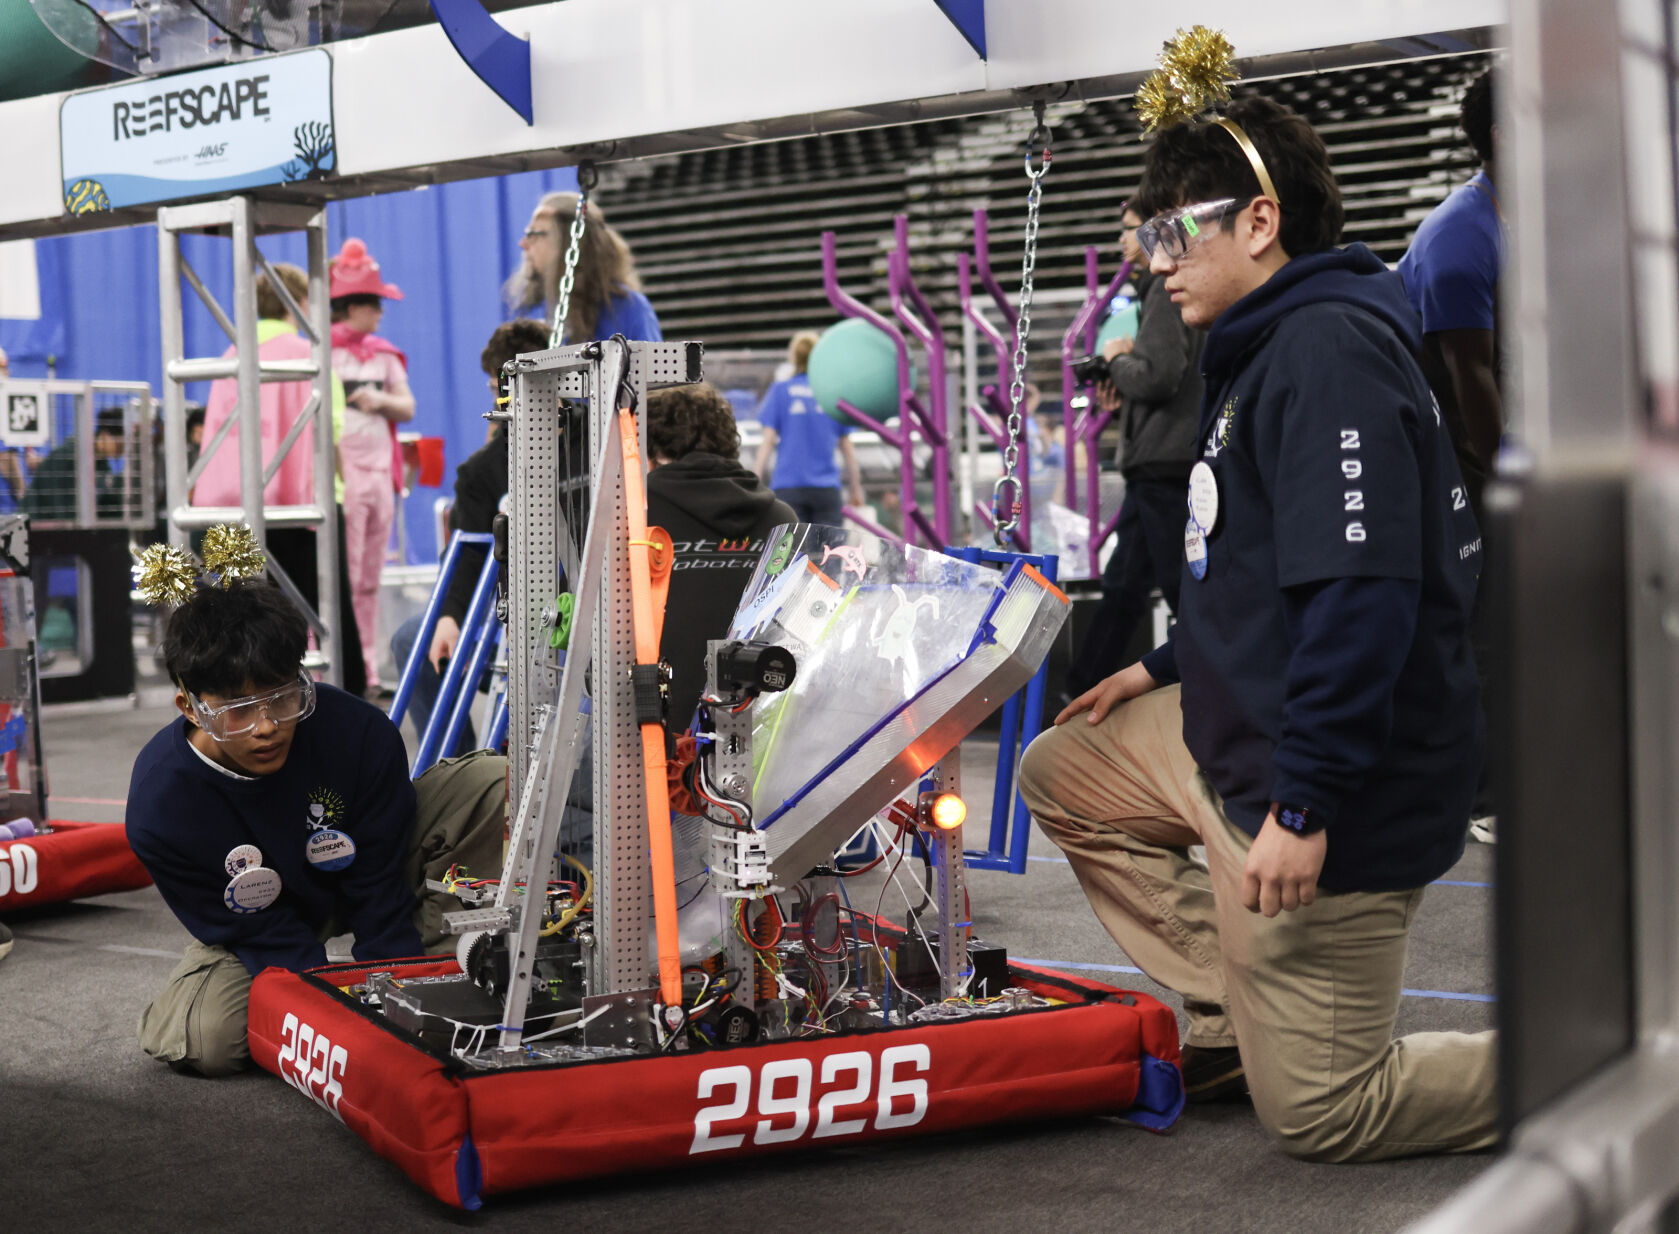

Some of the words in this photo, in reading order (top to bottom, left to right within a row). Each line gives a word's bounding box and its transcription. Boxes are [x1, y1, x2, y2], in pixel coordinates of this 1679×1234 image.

[113, 75, 270, 141] REEFSCAPE
[1340, 430, 1366, 542] 2926
[1451, 484, 1468, 511] 2
[672, 537, 765, 553] otwi
[753, 585, 775, 608] OSPI
[763, 673, 786, 686] NEO
[728, 1016, 741, 1043] NEO
[278, 1012, 348, 1125] 2926
[689, 1043, 931, 1155] 2926
